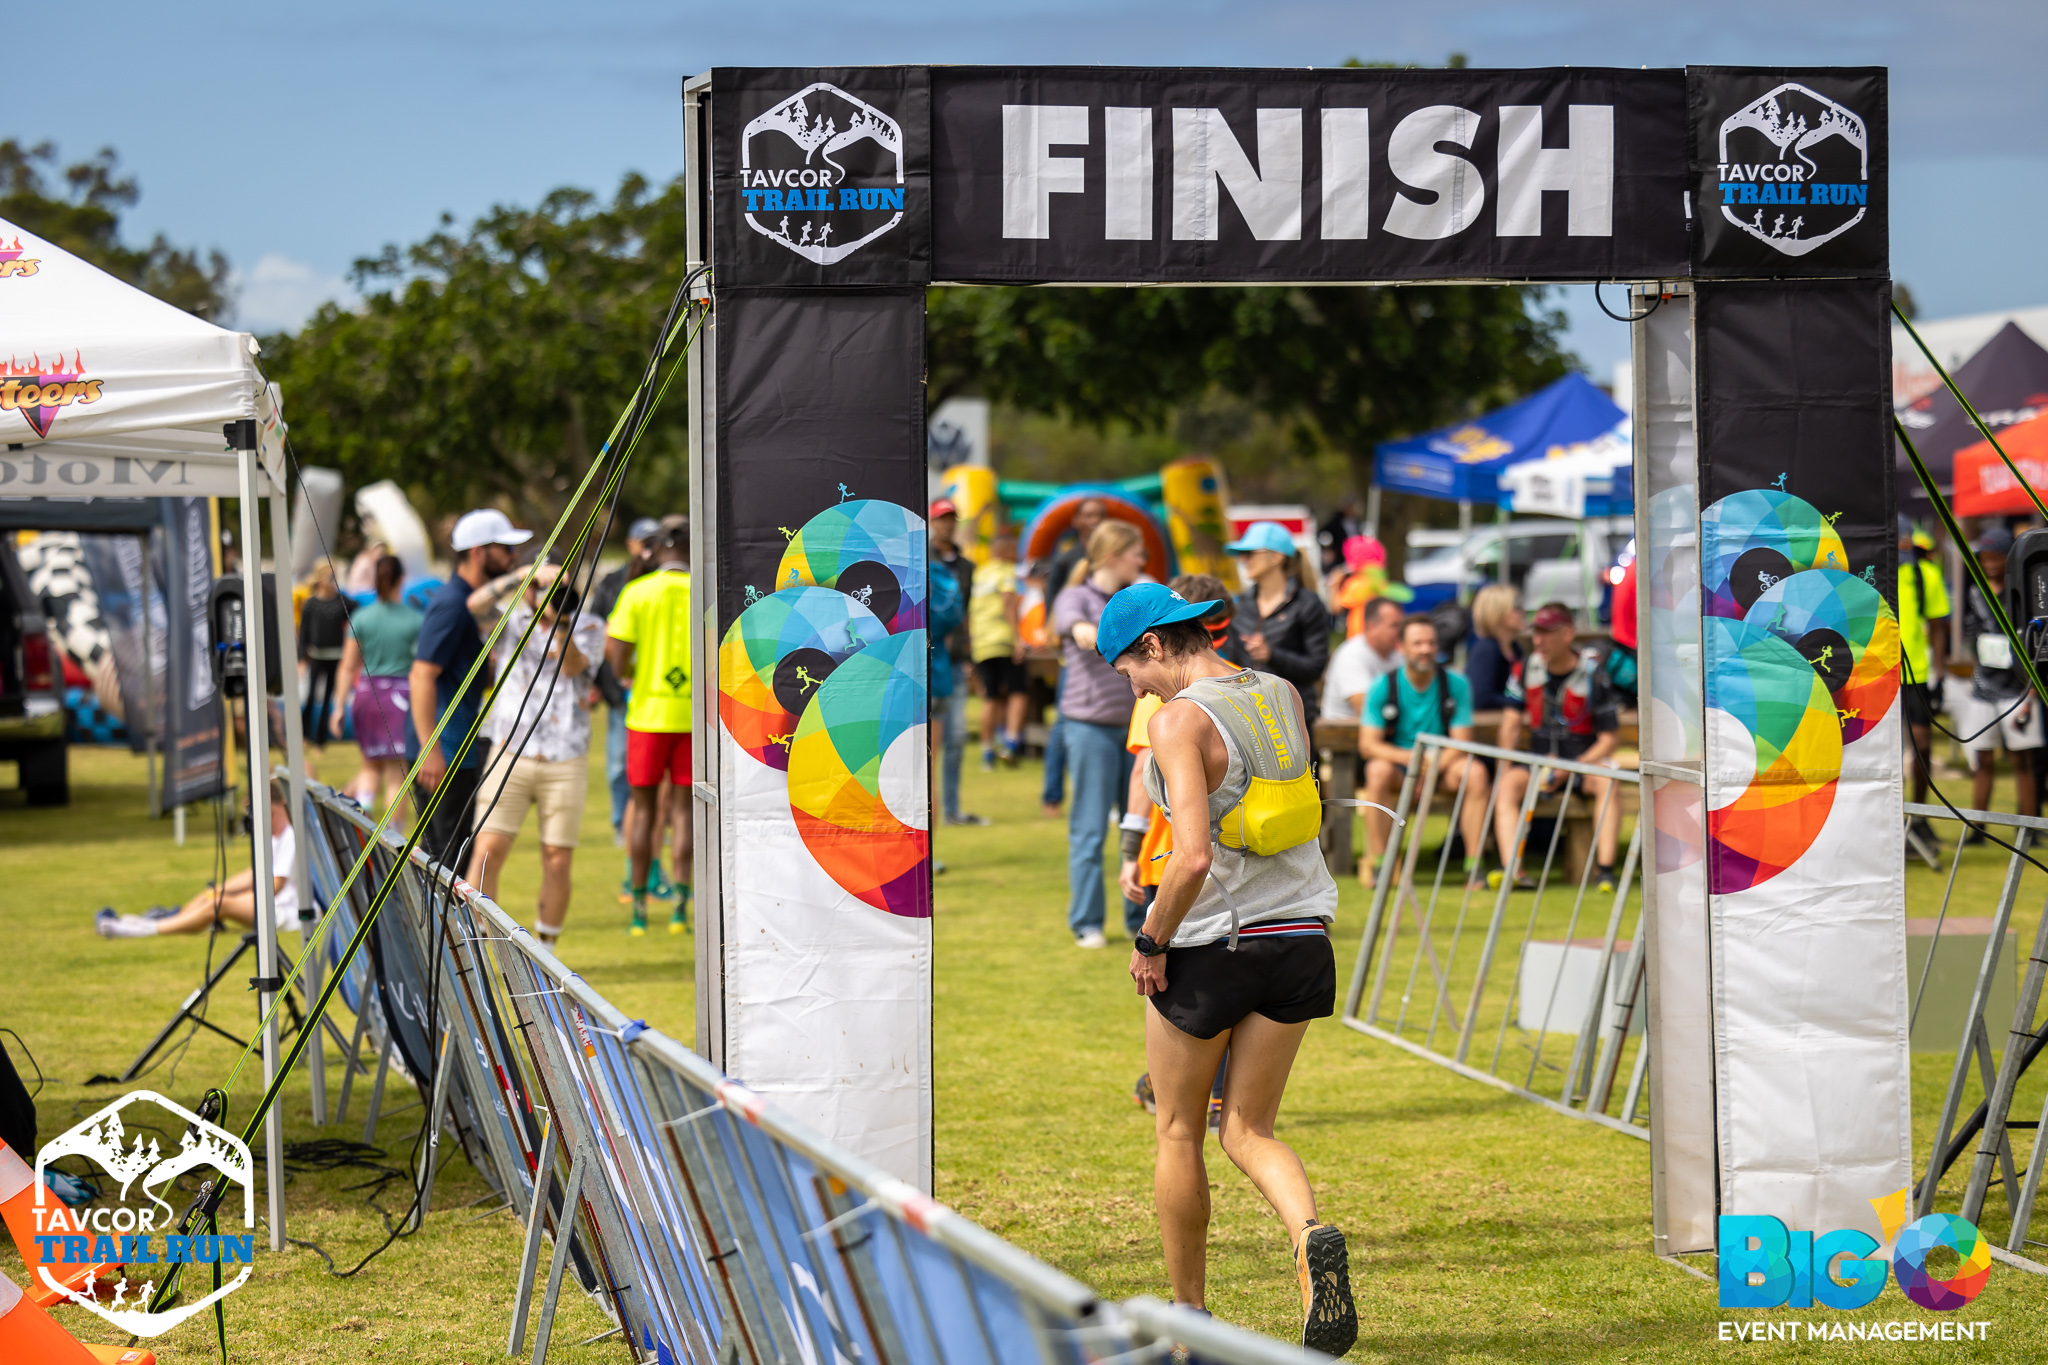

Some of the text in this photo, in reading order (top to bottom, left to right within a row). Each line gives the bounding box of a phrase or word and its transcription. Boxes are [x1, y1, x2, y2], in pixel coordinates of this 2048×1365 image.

[740, 169, 832, 187] TAVCOR
[1002, 104, 1614, 241] FINISH
[1717, 164, 1804, 181] TAVCOR
[742, 188, 904, 211] TRAIL RUN
[1719, 183, 1868, 205] TRAIL RUN
[0, 377, 104, 411] teers
[1250, 692, 1292, 770] AONIJIE
